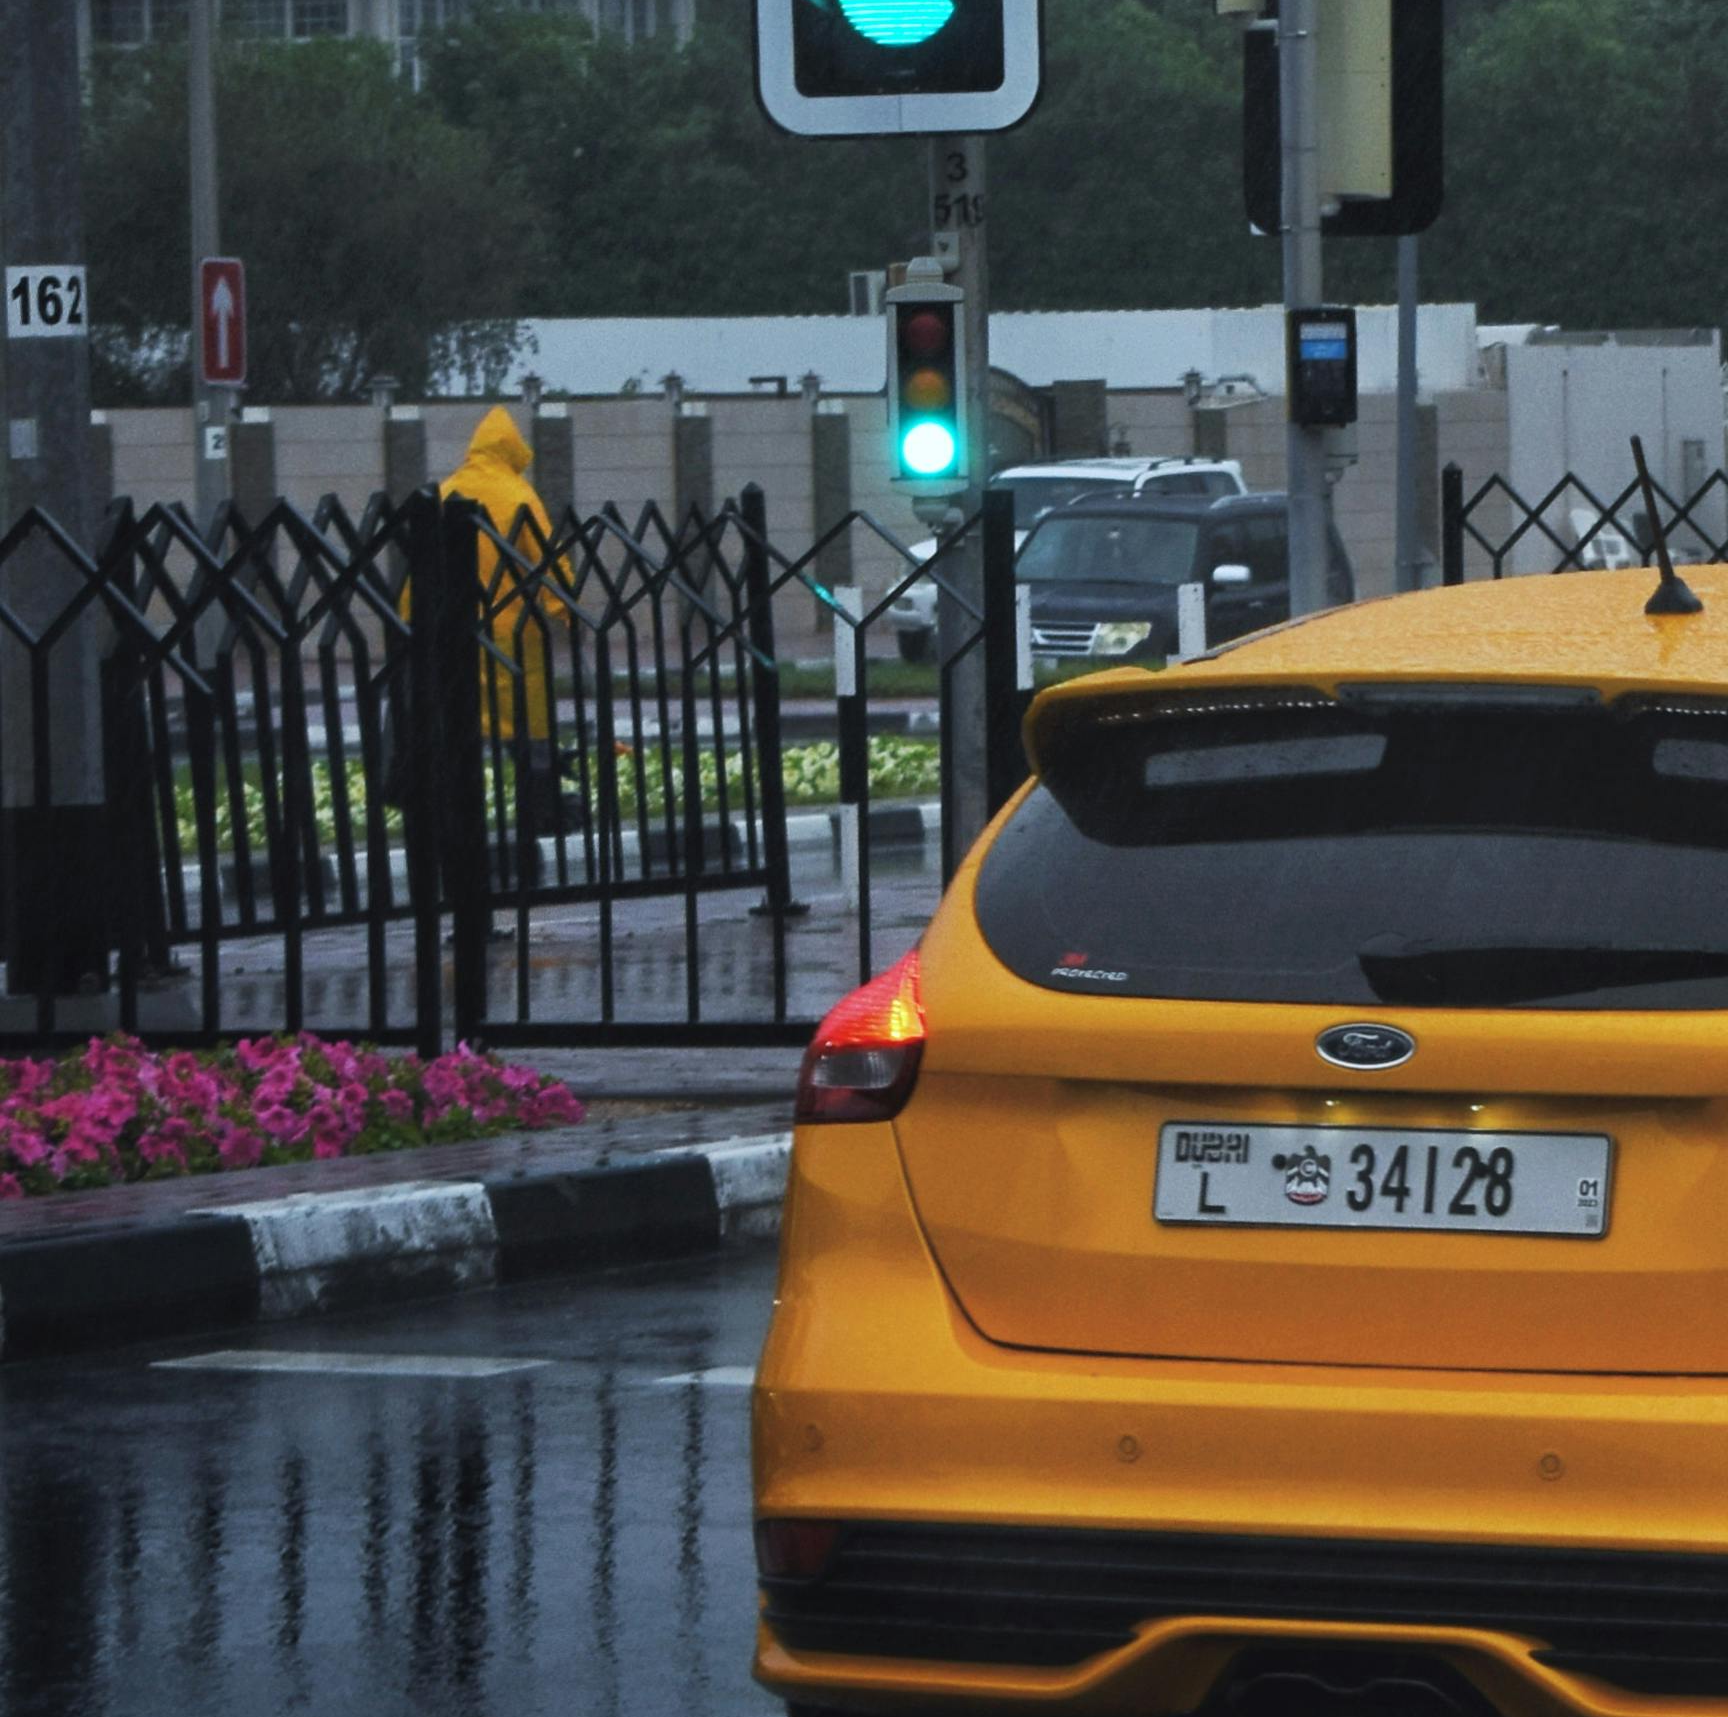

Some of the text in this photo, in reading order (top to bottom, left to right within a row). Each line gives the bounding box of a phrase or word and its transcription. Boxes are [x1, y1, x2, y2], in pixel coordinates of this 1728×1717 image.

[946, 152, 968, 182] 3
[12, 275, 82, 325] 162
[1337, 1032, 1393, 1059] Ford
[1174, 1131, 1249, 1163] DUBAI
[1198, 1171, 1226, 1214] L
[1346, 1143, 1514, 1217] 34128
[1579, 1179, 1598, 1197] 01
